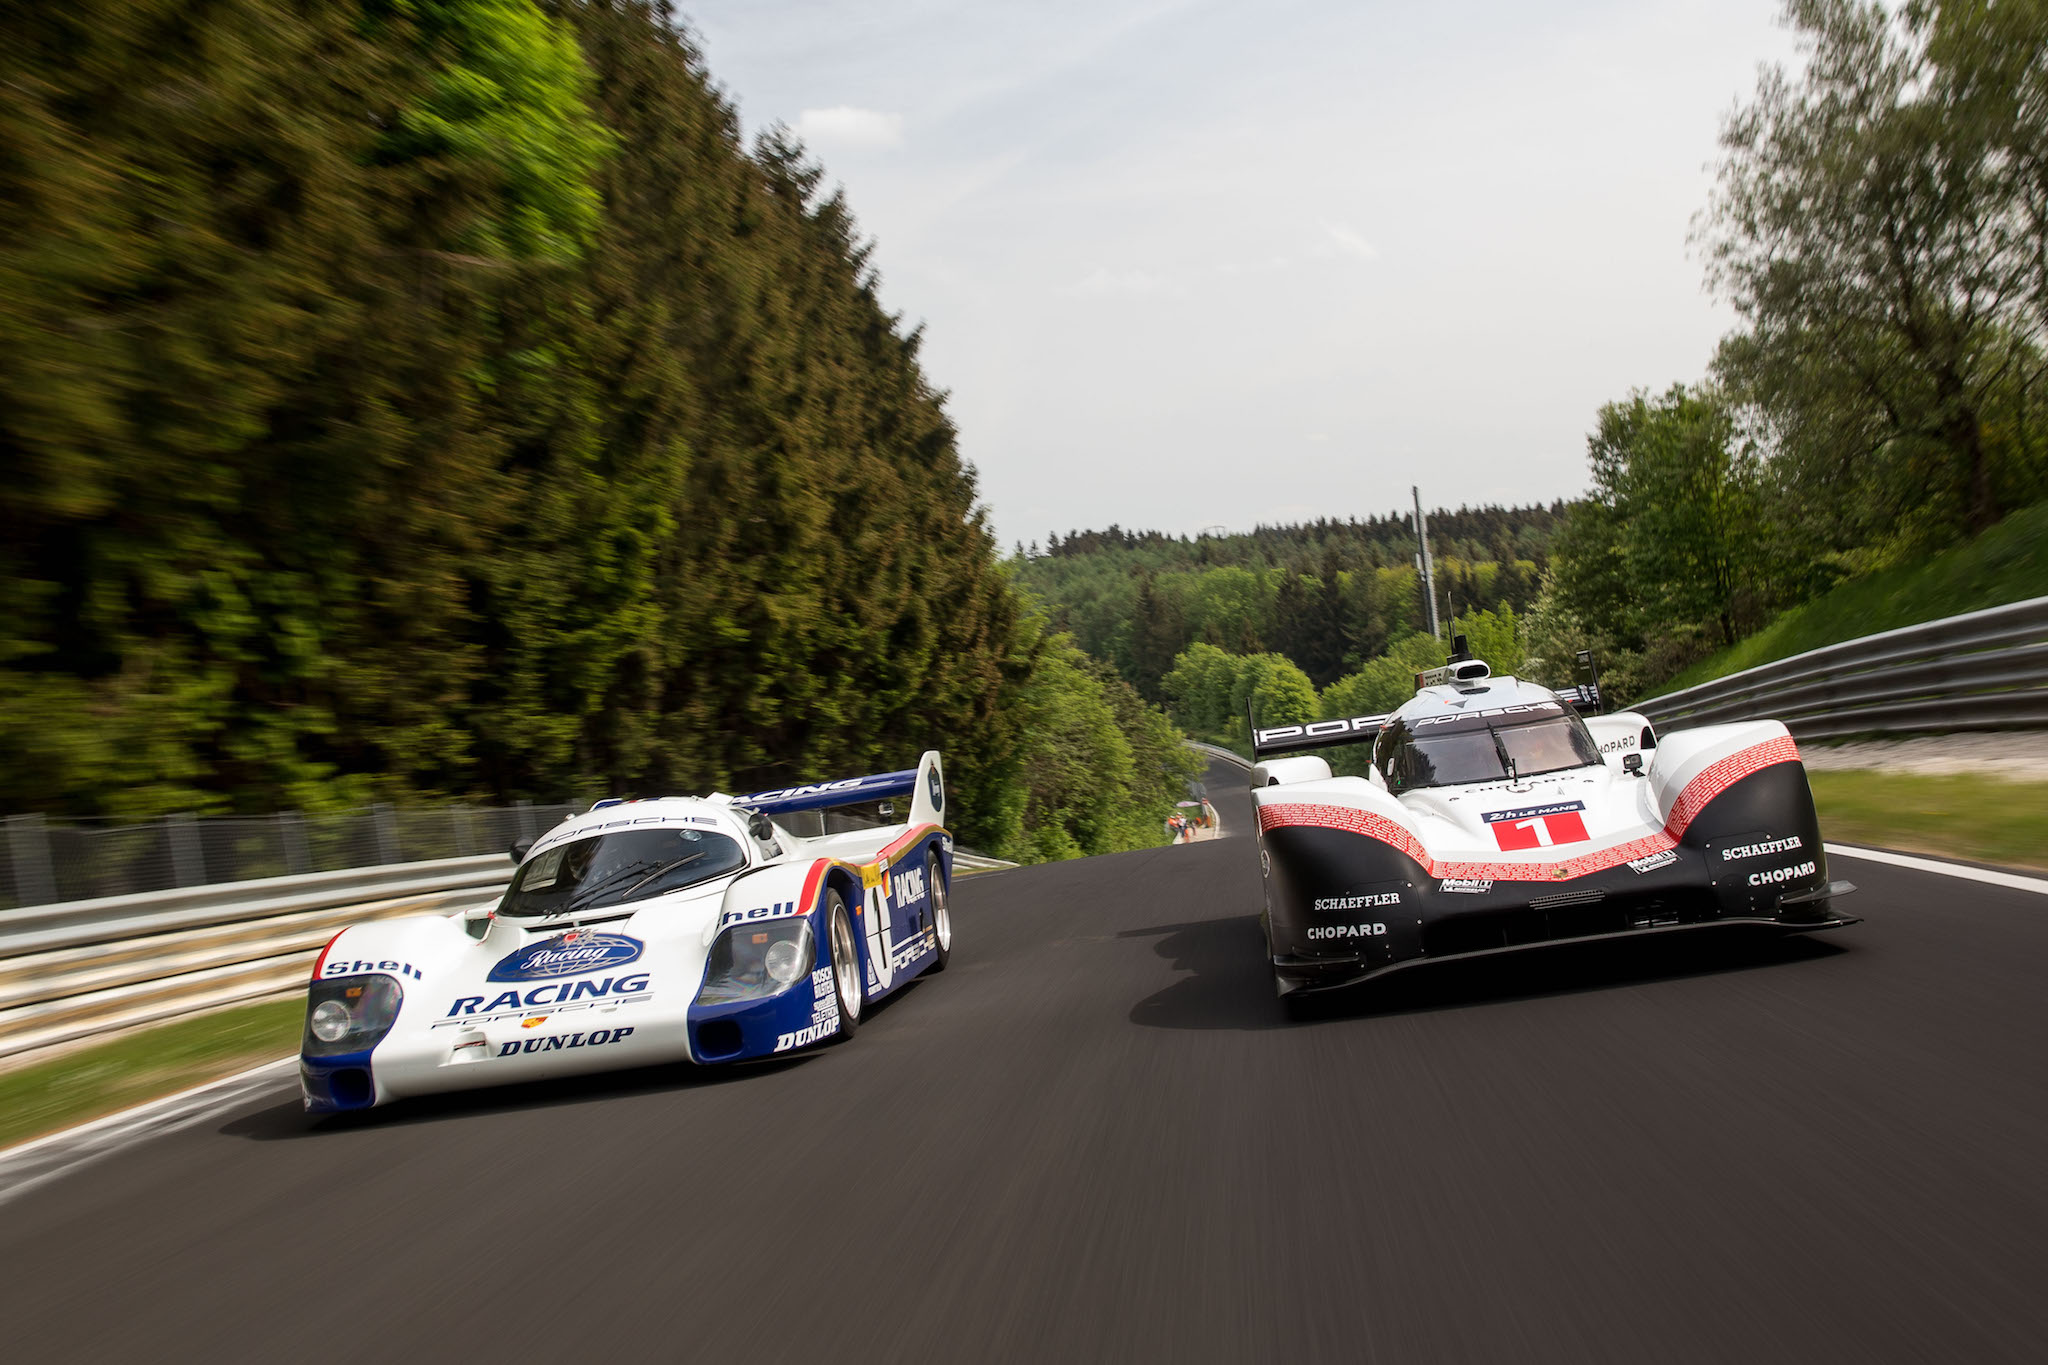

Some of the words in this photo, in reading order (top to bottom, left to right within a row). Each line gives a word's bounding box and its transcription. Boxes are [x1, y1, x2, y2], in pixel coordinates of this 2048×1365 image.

[1415, 701, 1563, 729] PORSCHE
[1598, 735, 1635, 754] HOPARD
[731, 778, 863, 804] ACING
[1519, 809, 1536, 817] LE
[1538, 804, 1579, 815] MANS
[532, 817, 718, 853] PORSCHE
[1515, 817, 1554, 847] 1
[1722, 835, 1802, 862] SCHAEFFLER
[1441, 879, 1480, 887] Mobil
[1748, 861, 1816, 887] CHOPARD
[893, 867, 925, 909] RACING
[1314, 892, 1400, 911] SCHAEFFLER
[716, 902, 793, 931] hell
[872, 887, 888, 970] 1
[1307, 922, 1387, 940] CHOPARD
[521, 945, 611, 970] Racing
[892, 933, 936, 974] PORSCHE
[325, 960, 422, 981] Shell
[812, 965, 834, 986] BOSCH
[447, 973, 651, 1018] RACING
[497, 1027, 635, 1057] DUNLOP
[774, 1014, 840, 1053] DUNLOP
